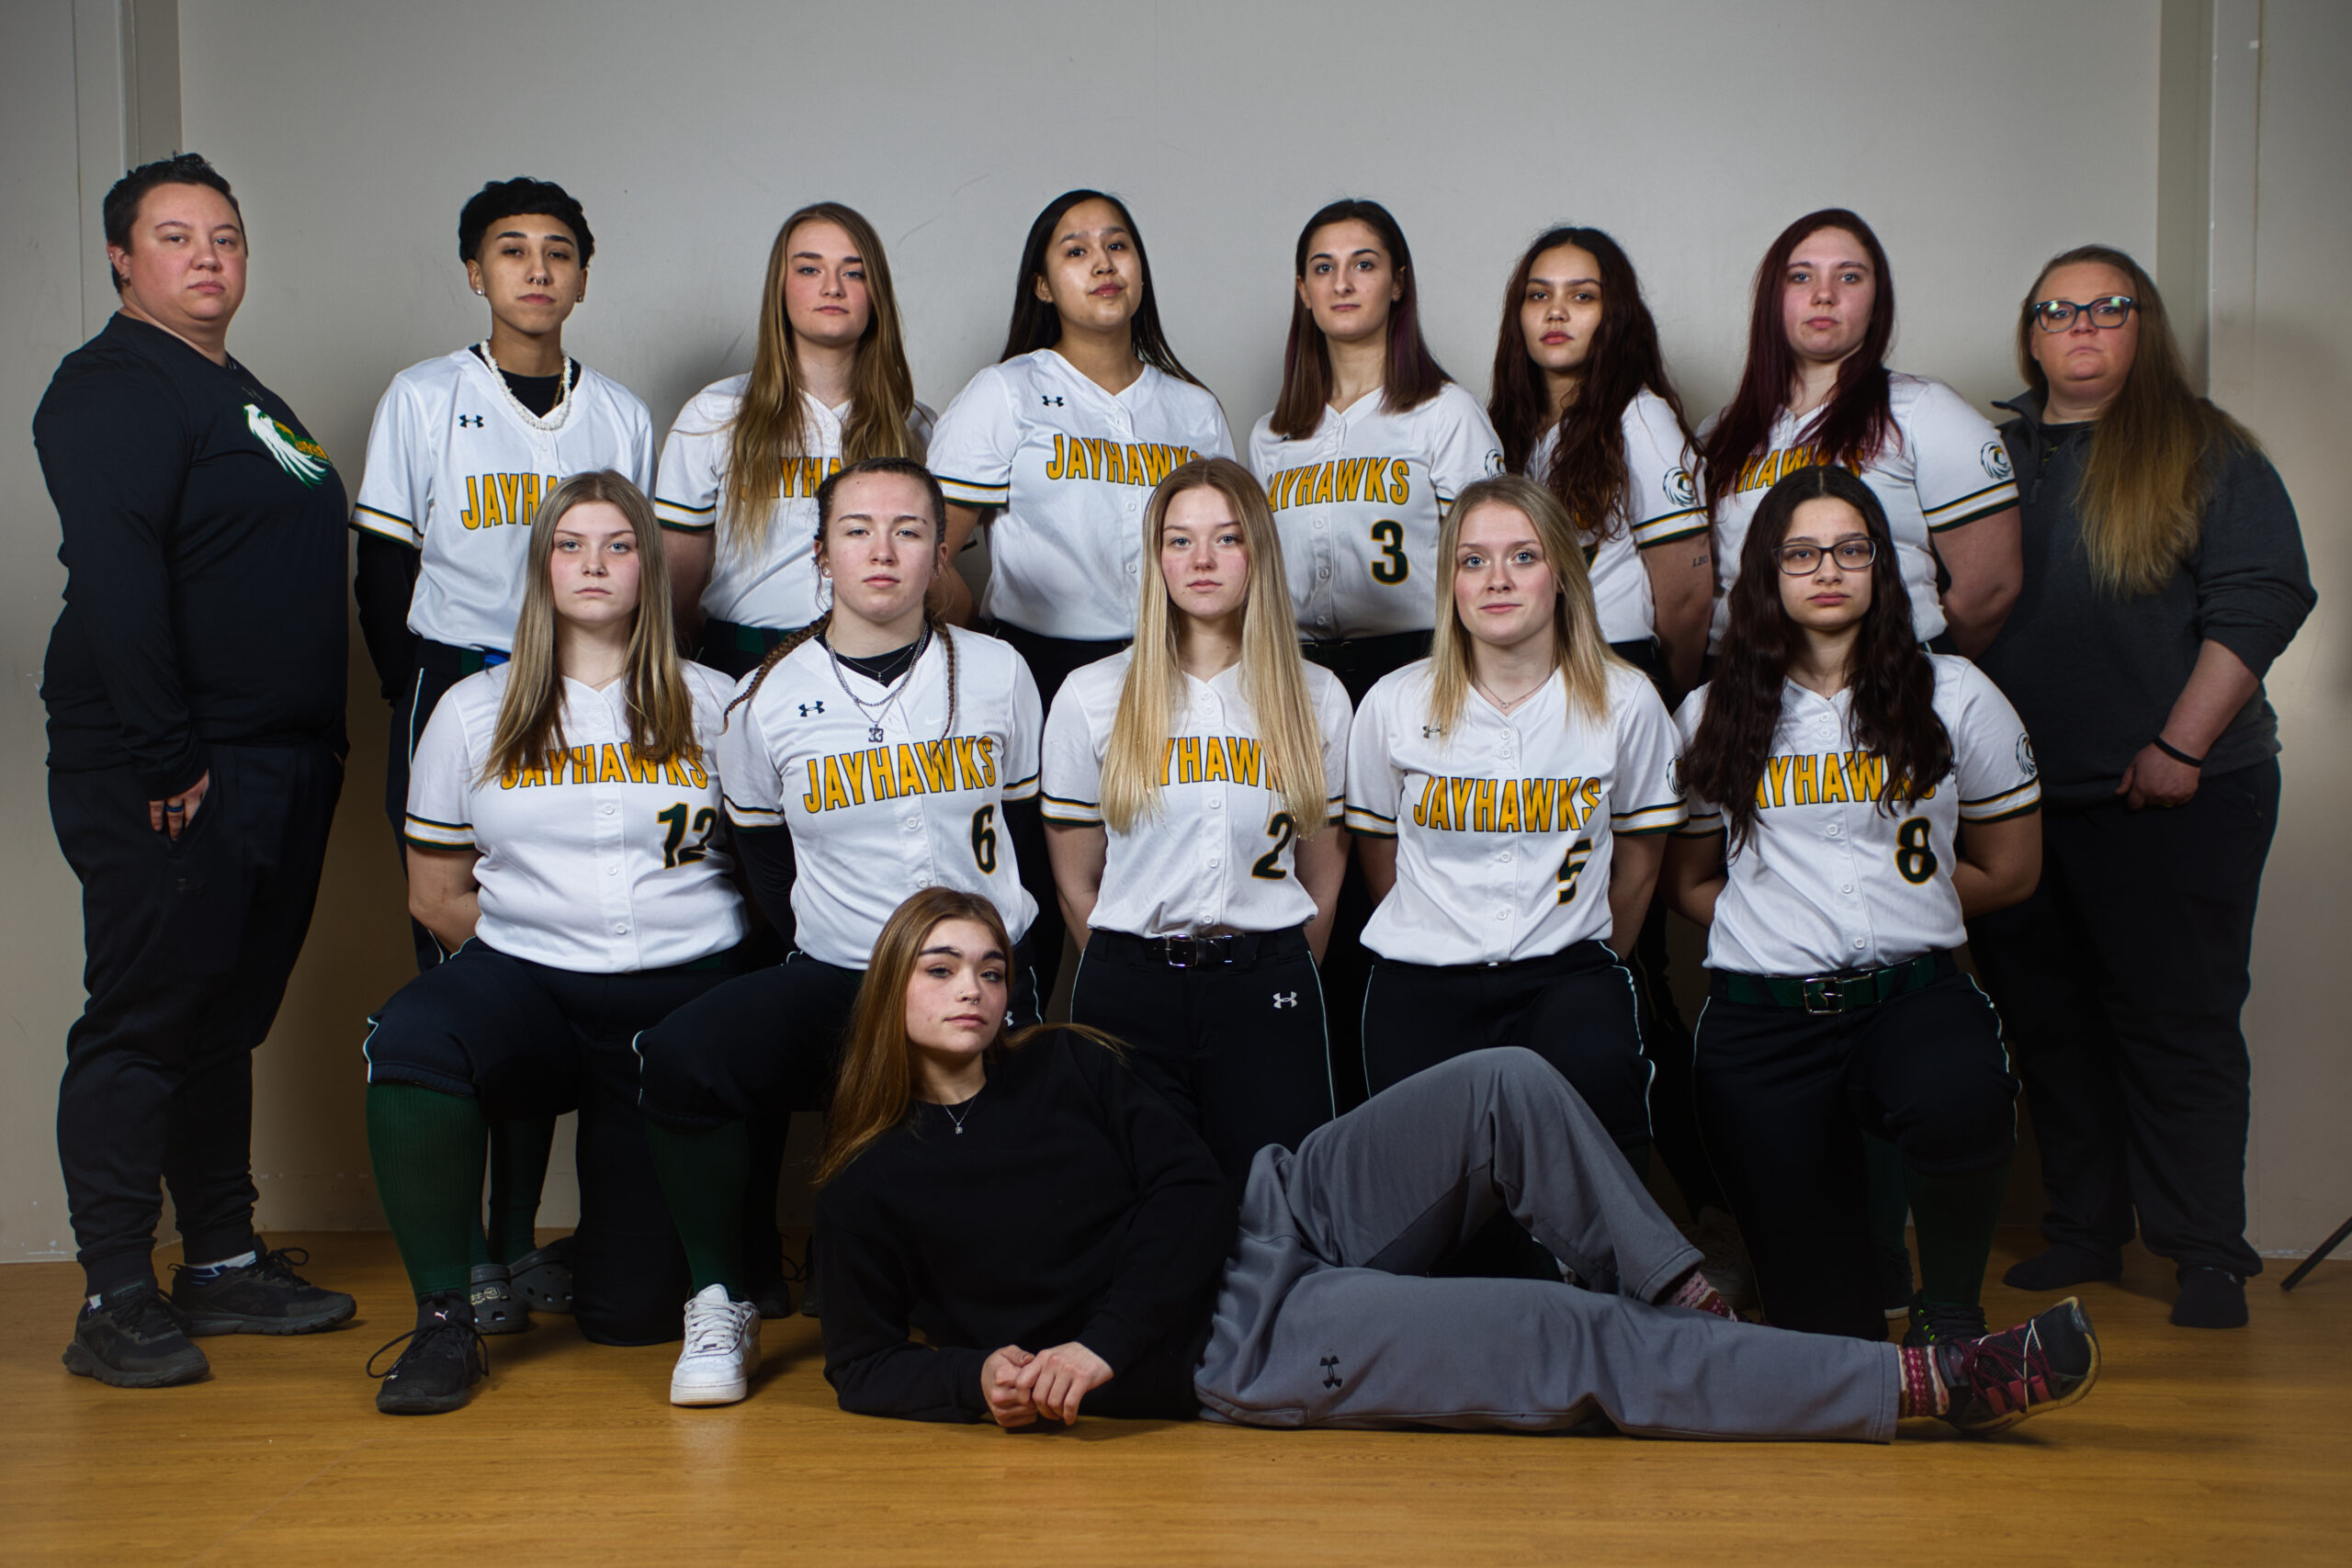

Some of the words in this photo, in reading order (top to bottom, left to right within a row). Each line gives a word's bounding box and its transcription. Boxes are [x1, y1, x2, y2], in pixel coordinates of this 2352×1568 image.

[1268, 457, 1409, 513] AYHAWKS
[1371, 519, 1409, 585] 3
[803, 736, 996, 814] JAYHAWKS
[1413, 775, 1601, 832] JAYHAWKS
[657, 802, 718, 870] 12
[971, 803, 997, 875] 6
[1251, 810, 1292, 880] 2
[1895, 817, 1938, 886] 8
[1557, 838, 1592, 905] 5
